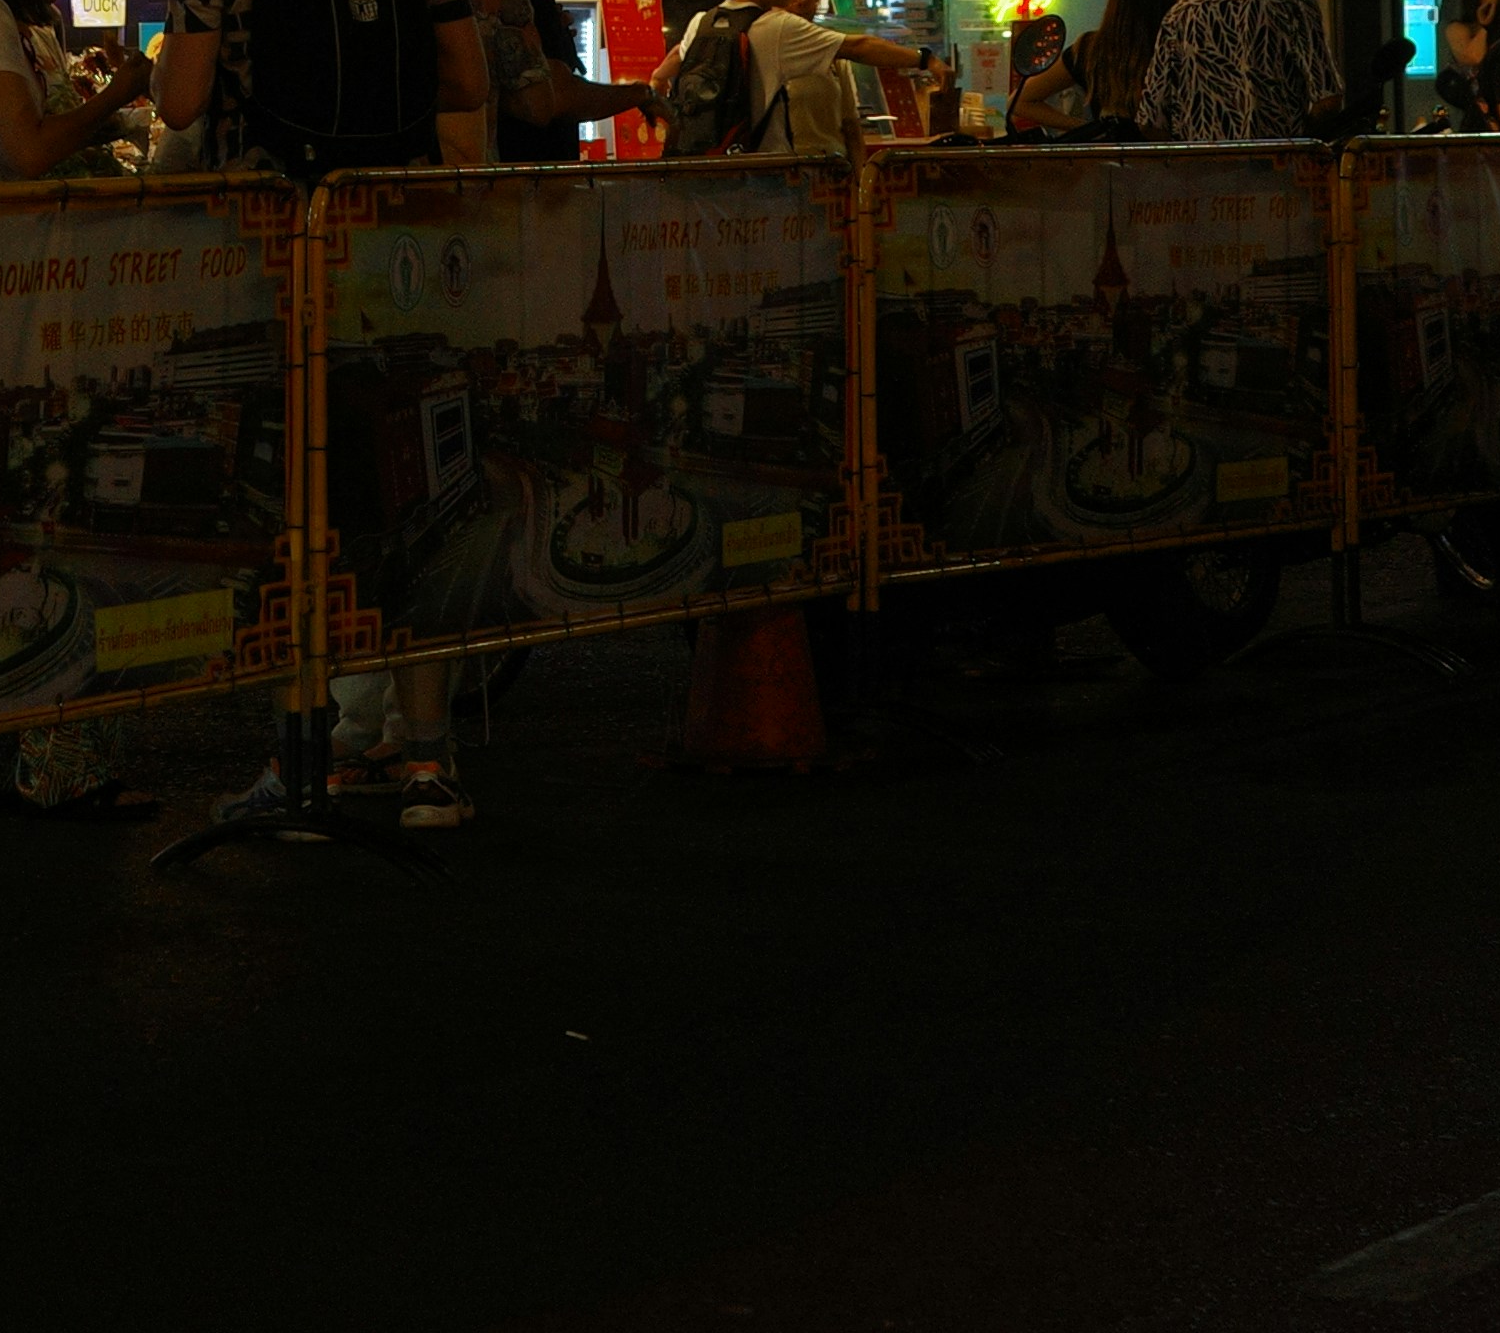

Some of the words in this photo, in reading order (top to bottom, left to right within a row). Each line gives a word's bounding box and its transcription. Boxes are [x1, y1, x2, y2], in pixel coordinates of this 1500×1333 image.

[1128, 196, 1199, 225] YAOWARAJ
[1211, 195, 1256, 221] STREET
[1269, 195, 1300, 220] FOOD
[622, 219, 702, 255] YAOWARAJ
[717, 216, 769, 247] STREET
[783, 213, 816, 242] FOOD
[108, 247, 183, 286] STREET
[200, 244, 247, 280] FOOD
